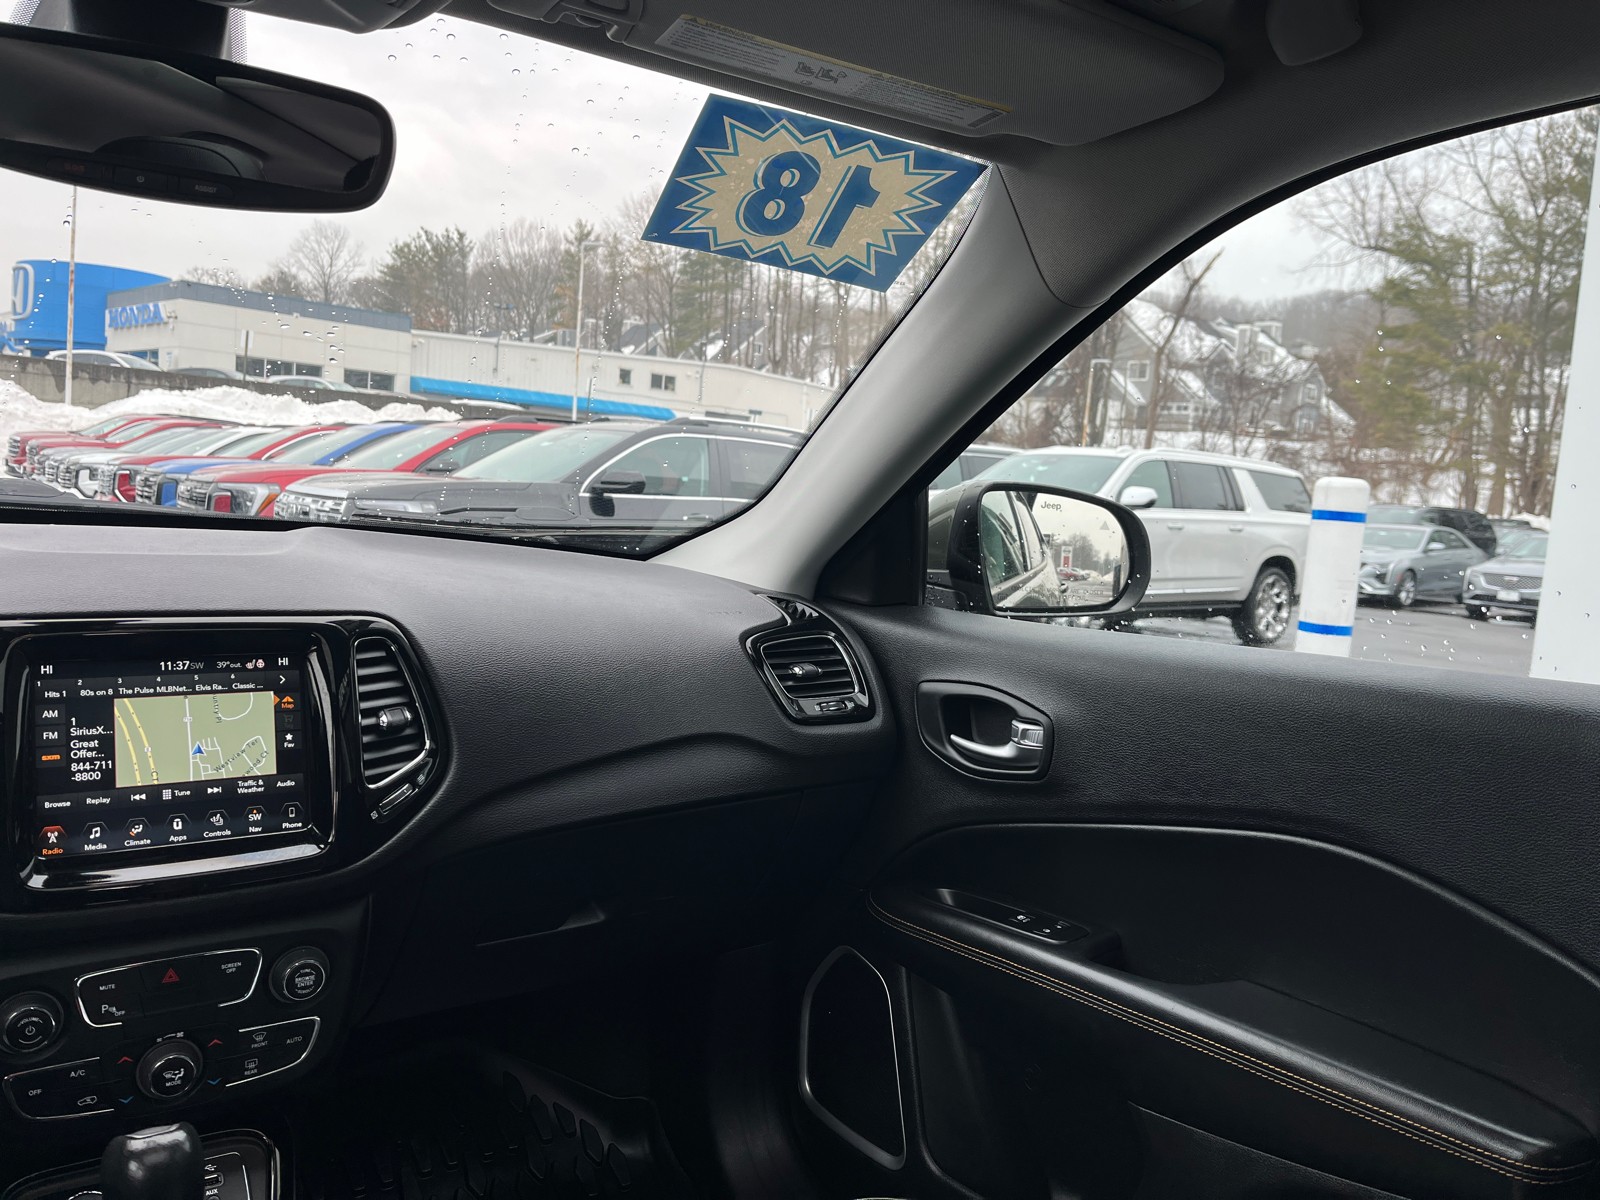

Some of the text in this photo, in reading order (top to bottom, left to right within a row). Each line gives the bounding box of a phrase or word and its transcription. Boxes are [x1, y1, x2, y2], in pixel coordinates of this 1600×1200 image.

[194, 184, 217, 194] ASSIST
[108, 302, 164, 329] HONDA
[1041, 501, 1062, 511] Jeep
[160, 660, 190, 671] 11:37
[278, 657, 289, 666] HI
[40, 665, 53, 674] HI
[80, 689, 95, 697] 80s
[118, 686, 154, 695] The Pulse
[42, 709, 58, 718] AM
[70, 717, 76, 726] 1
[43, 731, 58, 740] FM
[70, 739, 99, 749] Great
[214, 739, 258, 773] Westview Ter
[71, 760, 112, 772] 844-711
[71, 771, 101, 781] -8800
[174, 789, 191, 797] Tune
[237, 786, 265, 794] Weather
[44, 801, 71, 809] Browse
[86, 797, 111, 805] Replay
[248, 813, 262, 822] SW
[169, 834, 187, 842] Apps
[203, 829, 232, 838] Controls
[84, 843, 108, 851] Media
[124, 838, 151, 847] Climate
[42, 848, 64, 856] Radio
[221, 961, 242, 970] SCREEN
[99, 983, 116, 991] MUTE
[297, 980, 313, 988] ENTER
[251, 1040, 269, 1049] FRONT
[286, 1035, 303, 1045] AUTO
[69, 1069, 86, 1078] A/C
[244, 1068, 258, 1076] REAR
[165, 1079, 182, 1087] MODE
[28, 1088, 42, 1097] OFF
[205, 1188, 219, 1196] AUX
